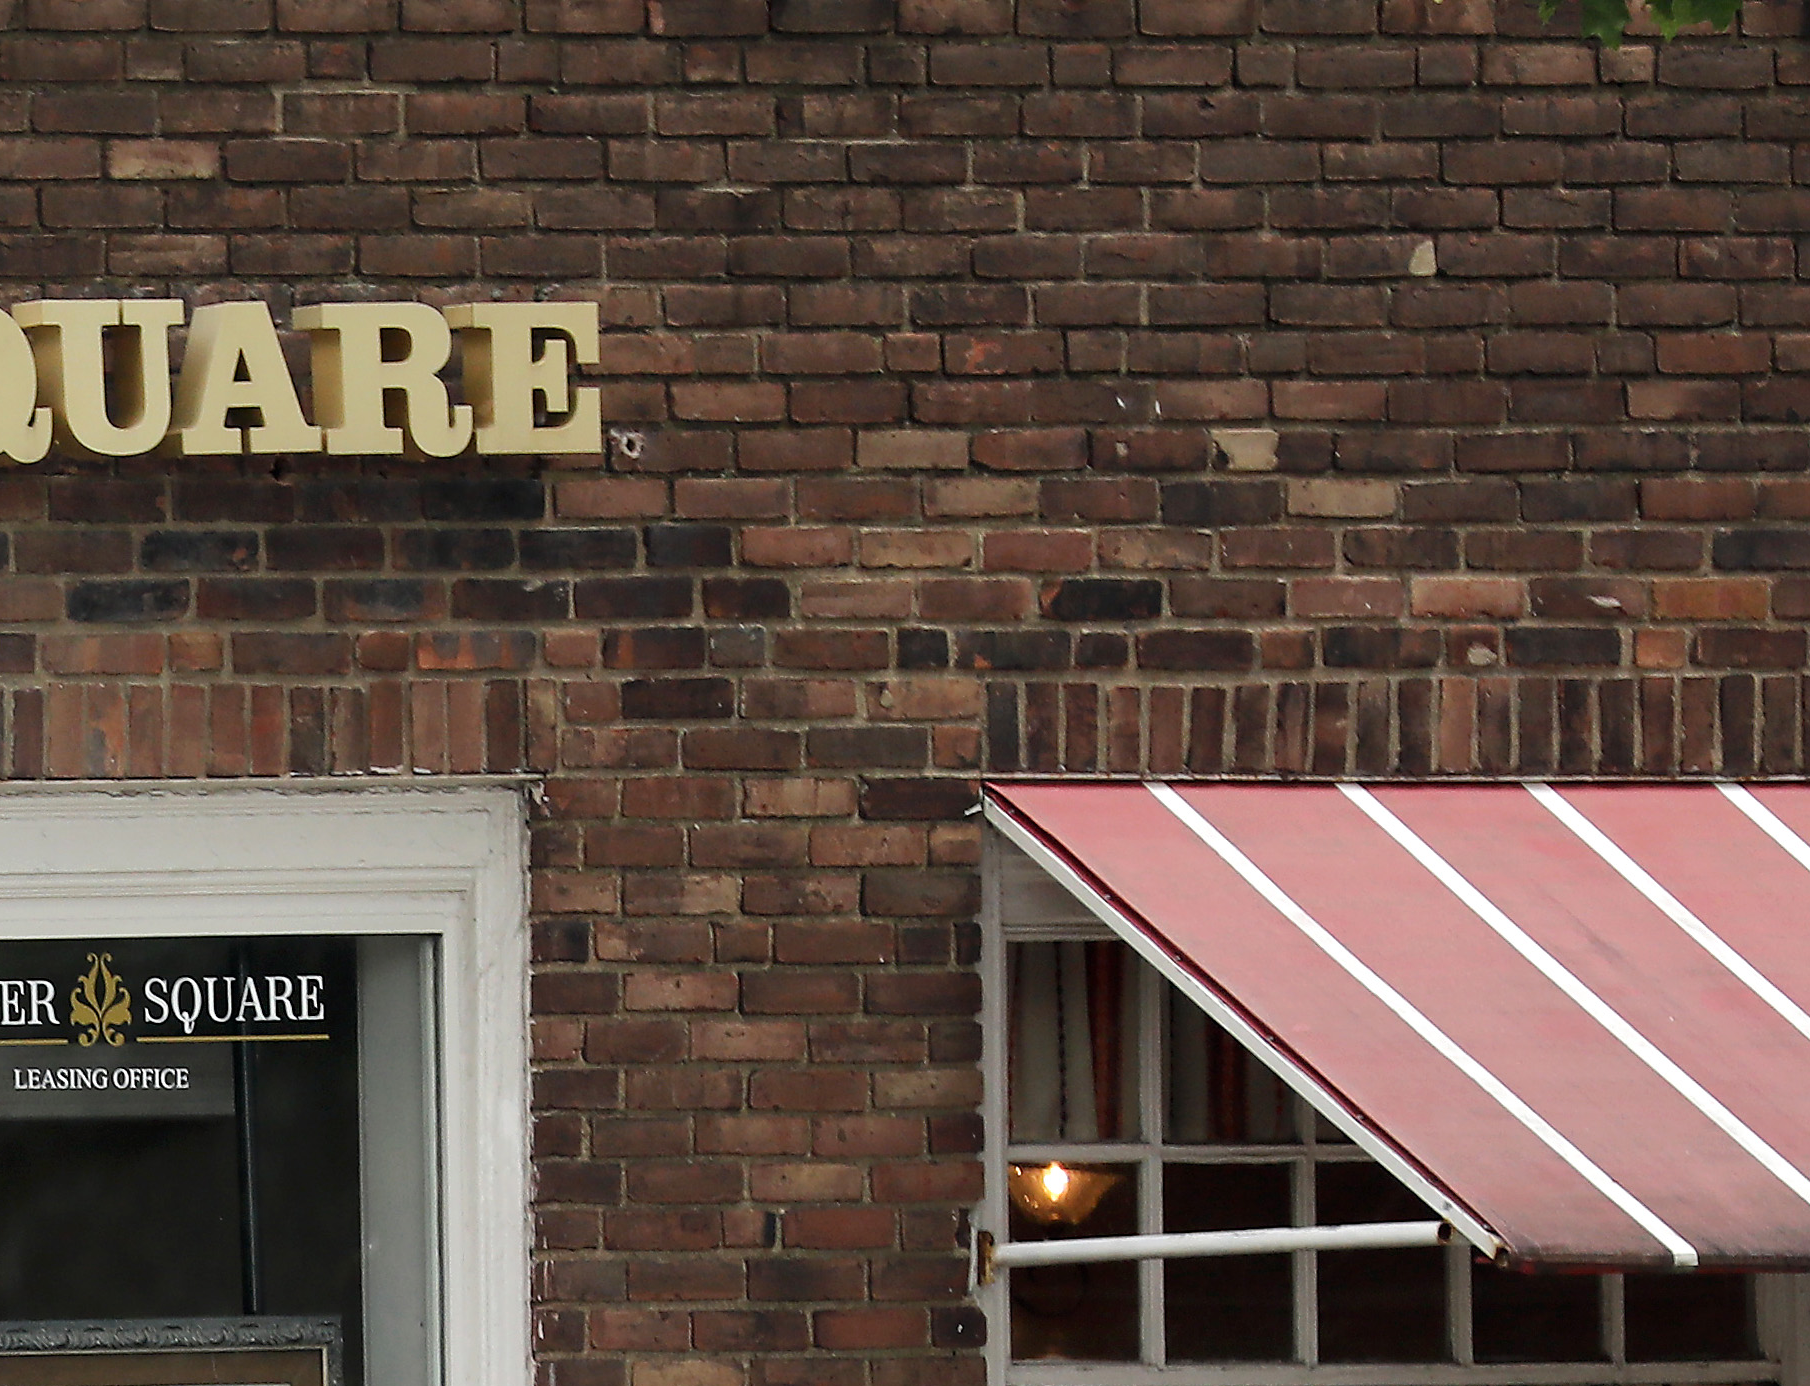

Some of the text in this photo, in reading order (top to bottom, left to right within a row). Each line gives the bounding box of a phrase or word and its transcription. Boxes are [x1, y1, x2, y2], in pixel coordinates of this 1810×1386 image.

[144, 975, 325, 1035] SQUARE
[14, 1067, 190, 1090] LEASING OFFICE
